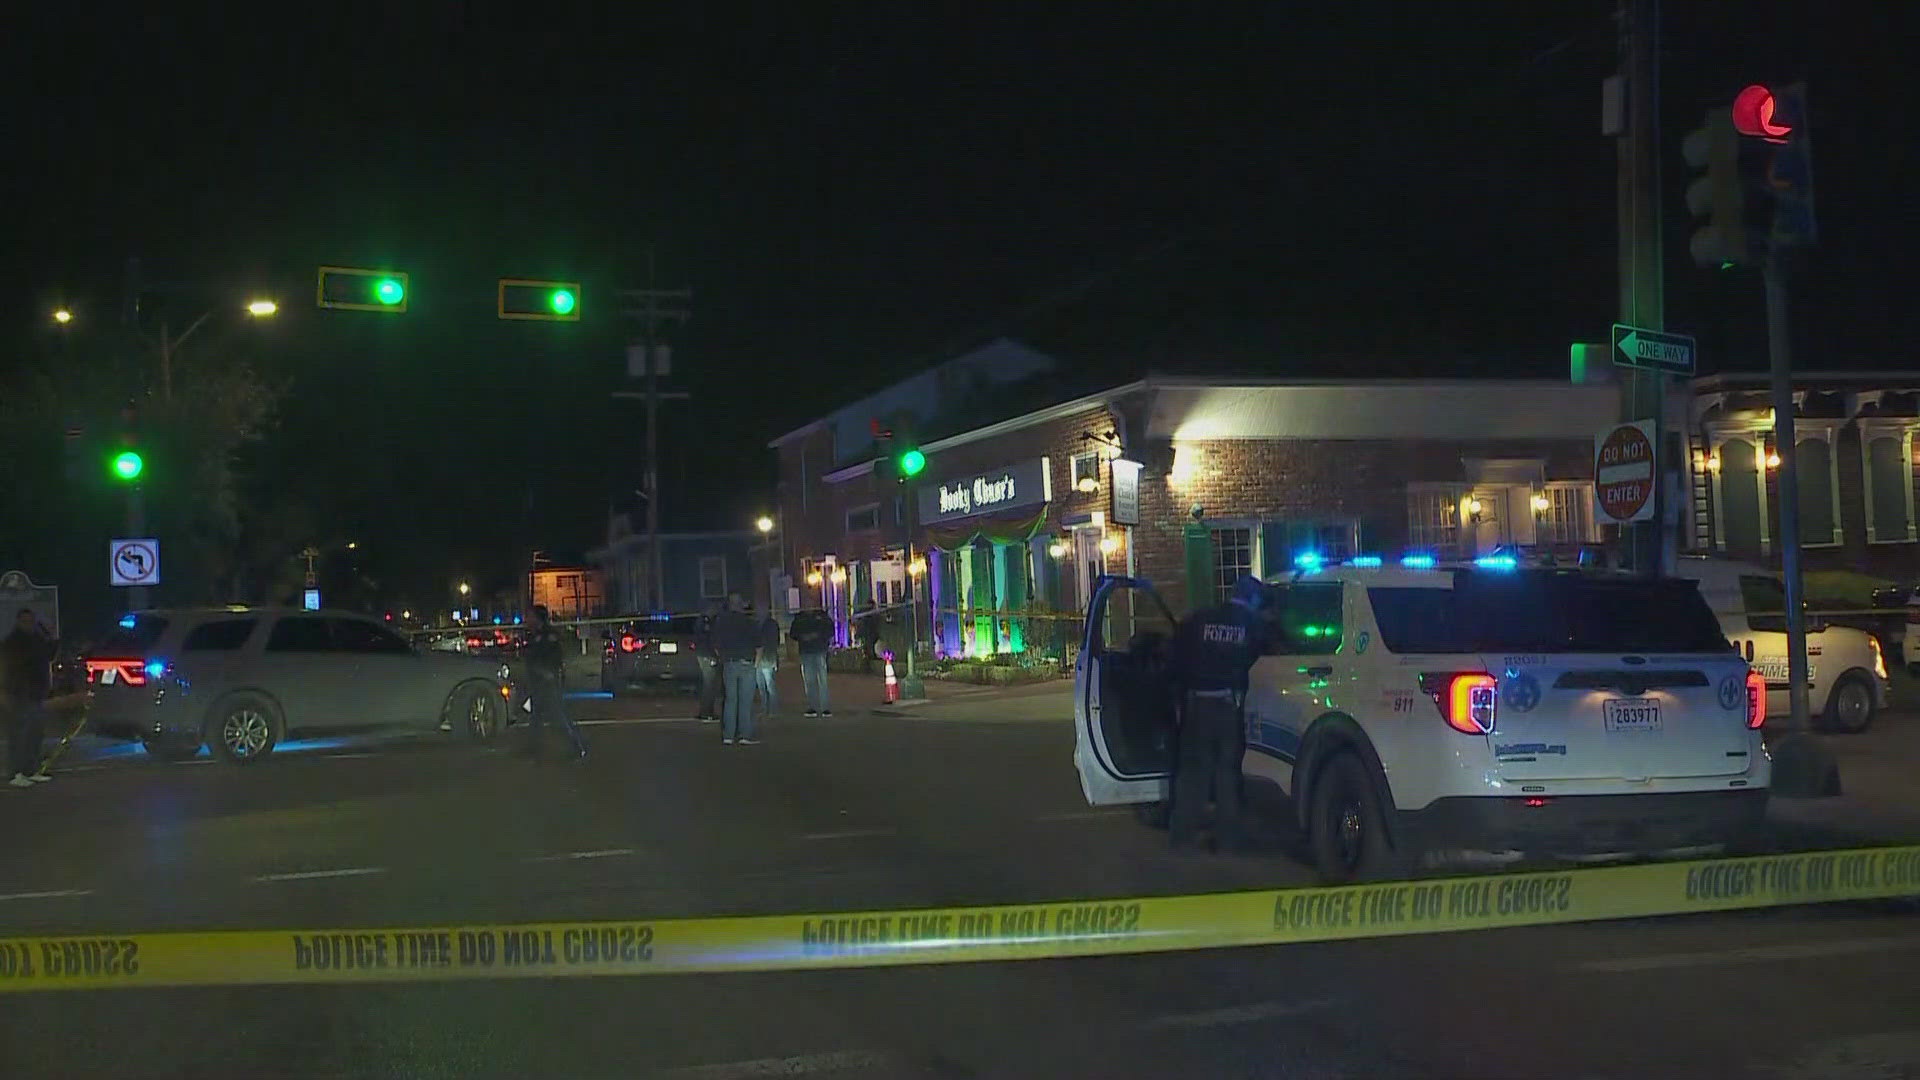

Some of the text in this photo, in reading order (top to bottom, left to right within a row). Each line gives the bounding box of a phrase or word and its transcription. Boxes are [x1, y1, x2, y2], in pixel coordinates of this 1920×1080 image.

[1637, 340, 1686, 363] ONE WAY
[1604, 440, 1645, 463] DO NOT
[939, 474, 1016, 514] Dooky Chase's
[1607, 485, 1641, 504] ENTER
[1203, 630, 1246, 643] POLICE
[1394, 697, 1413, 712] 911
[1616, 707, 1659, 724] 283977
